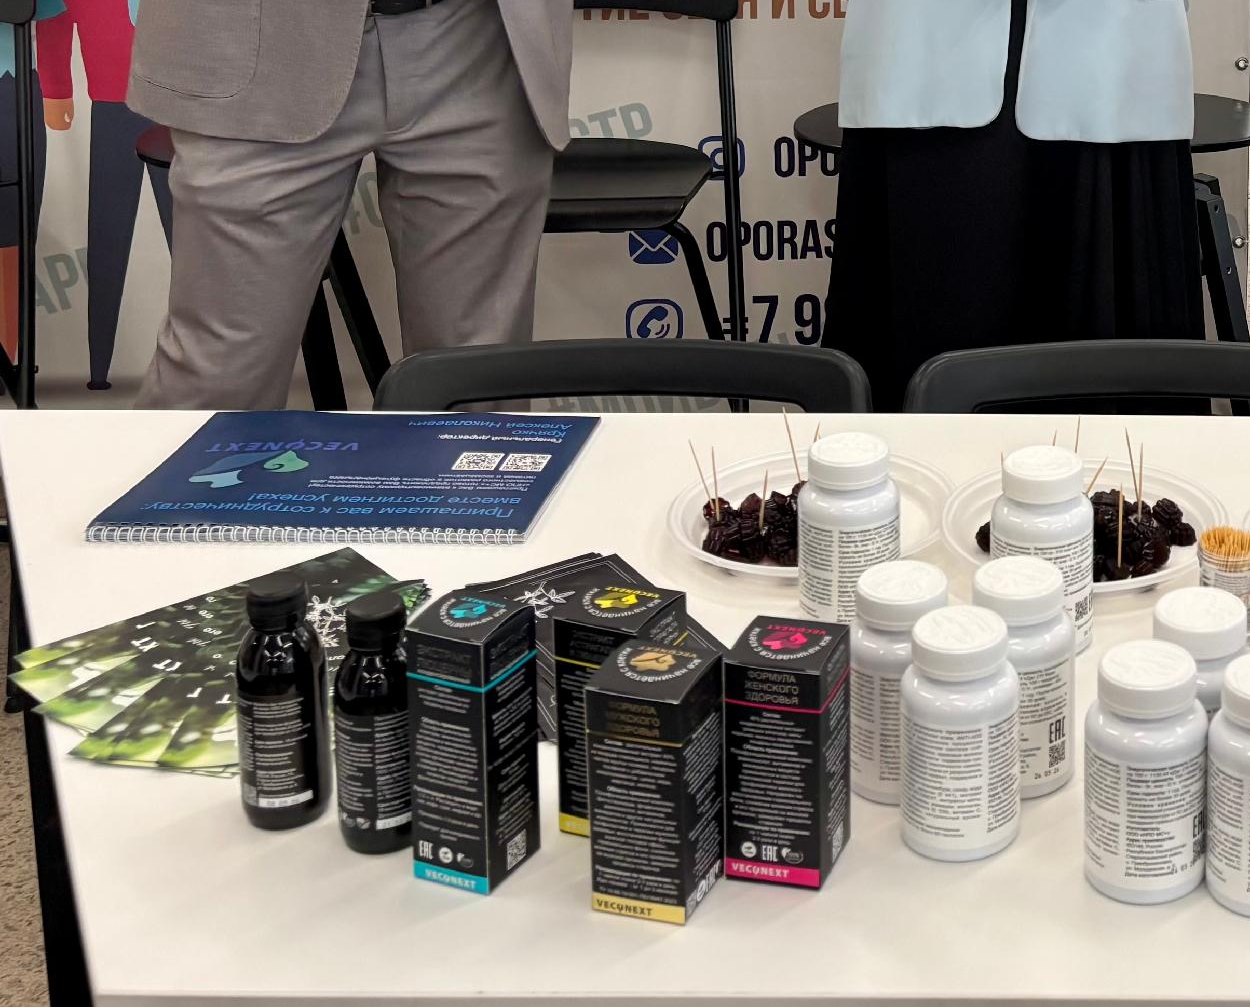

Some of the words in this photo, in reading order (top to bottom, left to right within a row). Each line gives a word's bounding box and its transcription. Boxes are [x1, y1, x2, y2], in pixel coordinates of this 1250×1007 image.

[247, 492, 329, 503] успеха!
[333, 494, 443, 505] достигнем
[446, 495, 522, 505] вместе
[319, 504, 334, 516] к
[336, 503, 374, 517] вас
[380, 502, 517, 519] Приглашаем
